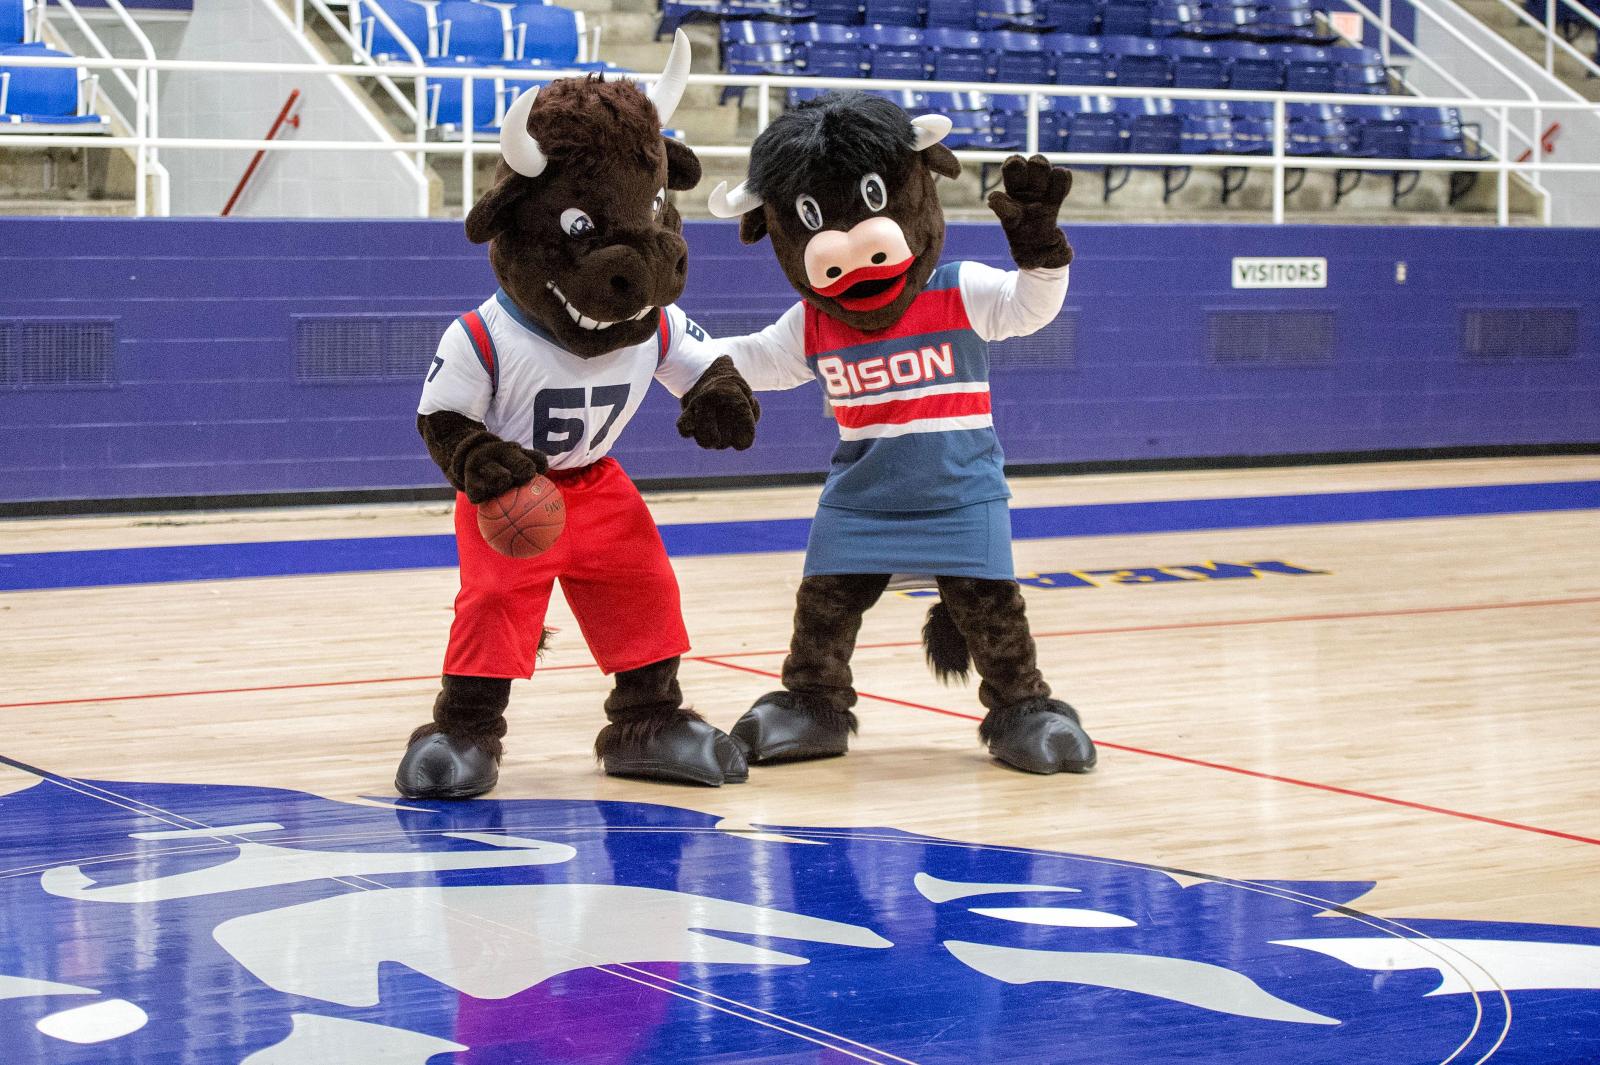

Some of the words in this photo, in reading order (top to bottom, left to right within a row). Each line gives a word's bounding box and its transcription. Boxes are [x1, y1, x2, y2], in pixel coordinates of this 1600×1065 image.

[1239, 263, 1321, 282] VISITORS
[817, 342, 955, 397] BISON
[532, 383, 631, 457] 67
[897, 559, 1333, 600] MEA
